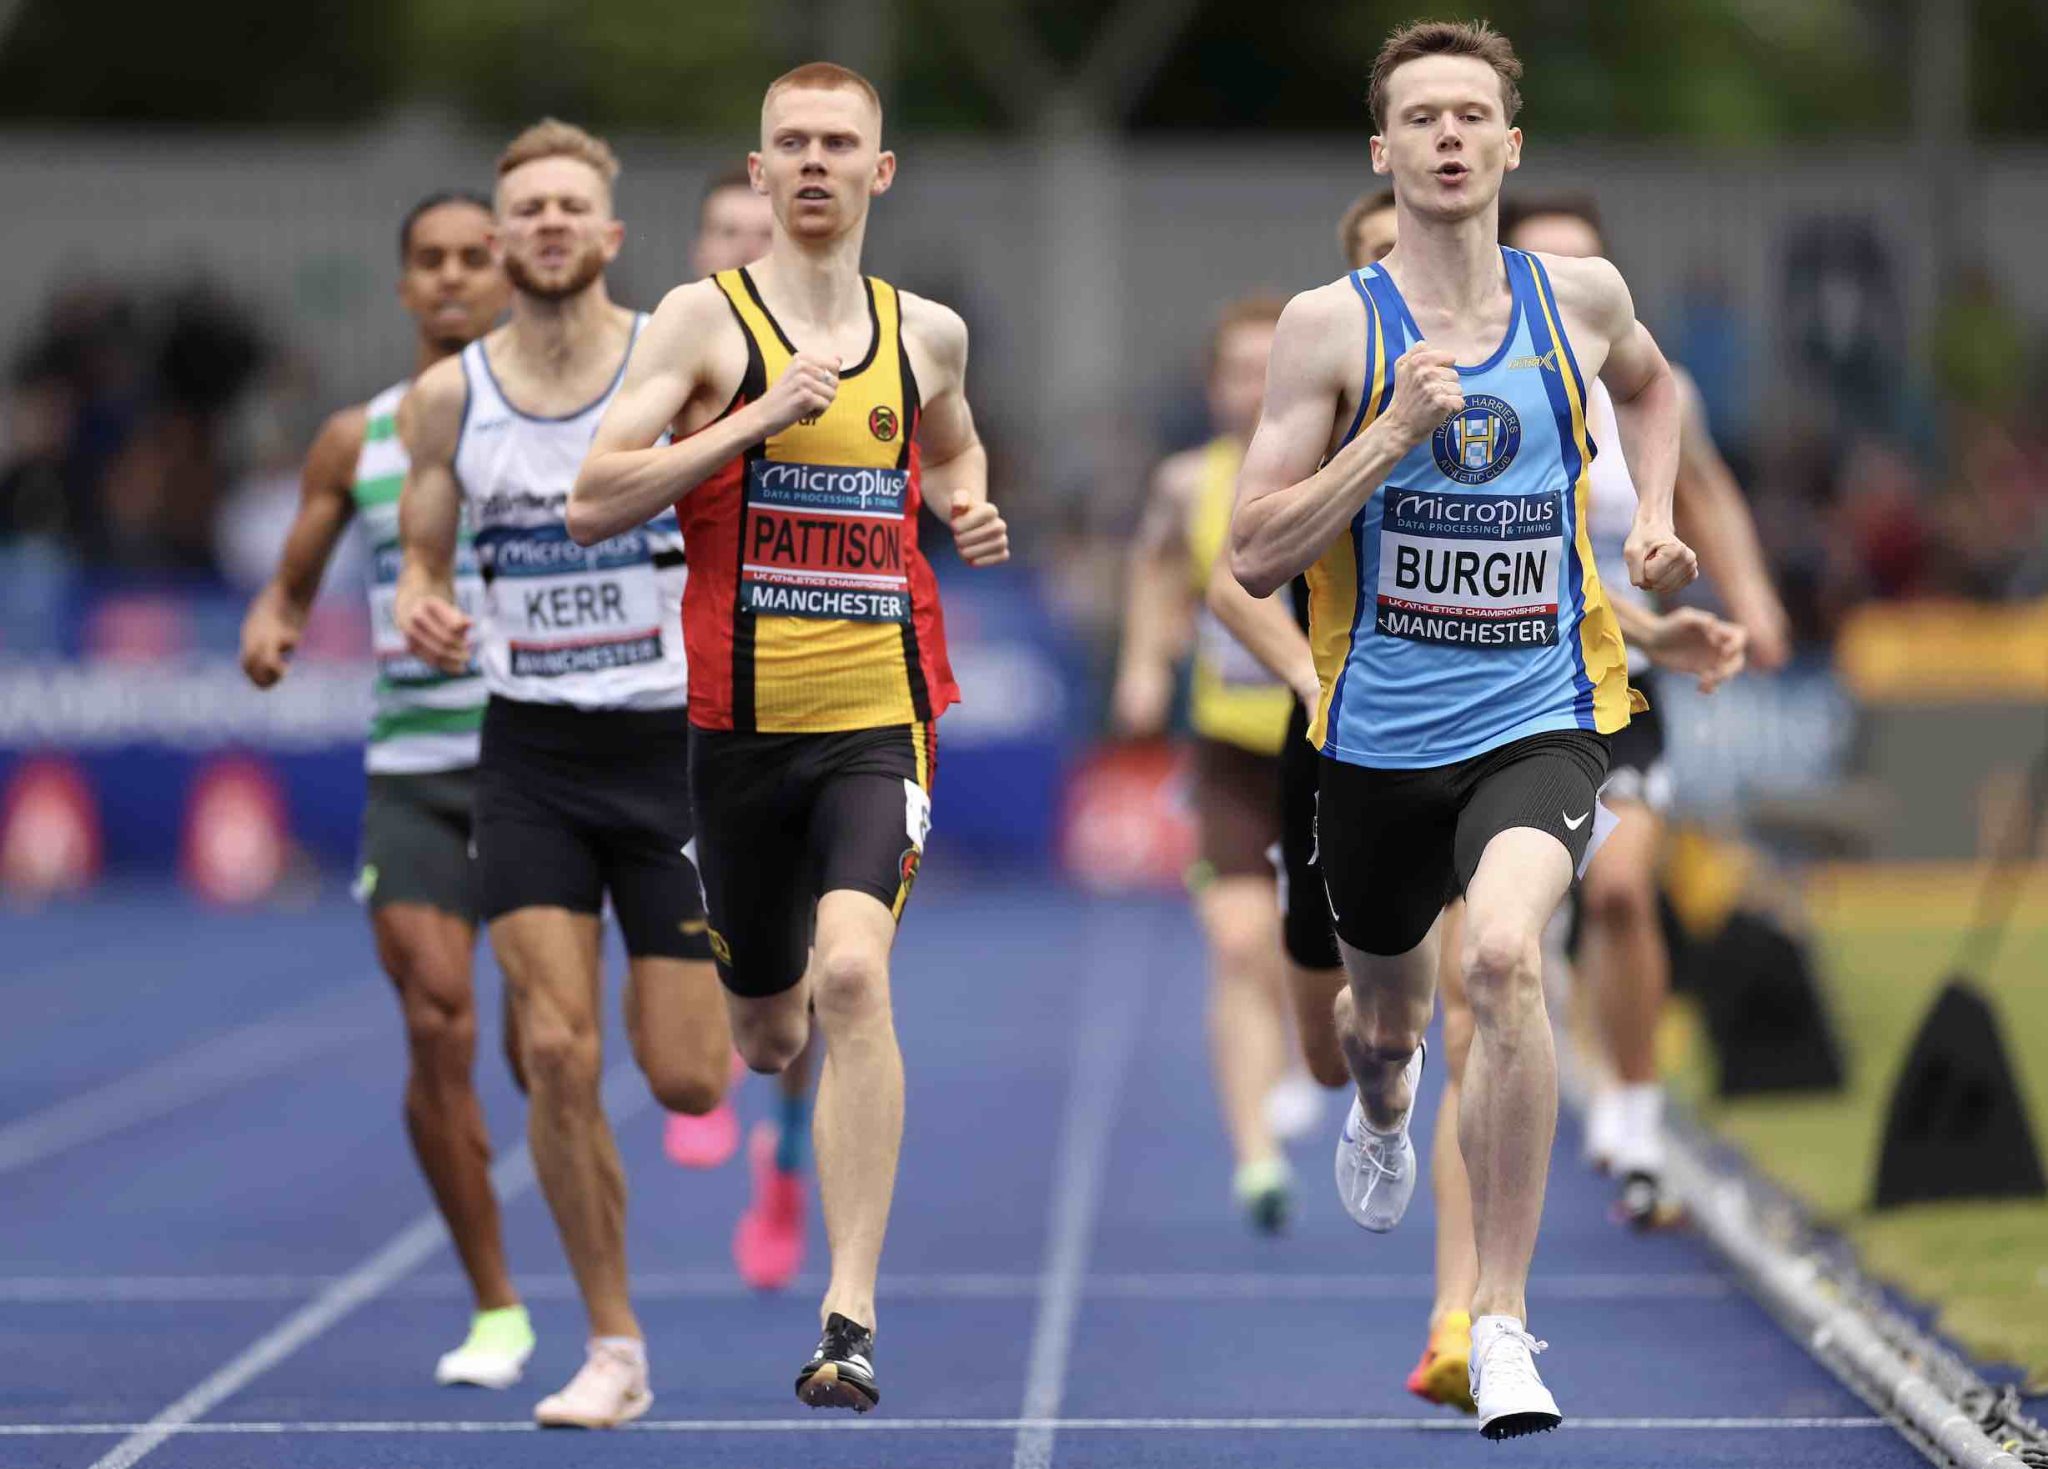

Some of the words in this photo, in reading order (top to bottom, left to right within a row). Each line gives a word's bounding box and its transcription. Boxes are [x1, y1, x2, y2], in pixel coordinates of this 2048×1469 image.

[1472, 397, 1518, 434] HARRIERS
[1440, 459, 1485, 483] ATHLETIC
[1486, 455, 1511, 478] CLUB
[763, 489, 790, 499] DATA
[794, 490, 860, 506] PROCESSING
[1397, 518, 1425, 530] DATA
[1429, 522, 1500, 534] PROCESSING
[1507, 525, 1514, 534] &
[1517, 522, 1551, 534] TIMING
[754, 516, 900, 569] PATTISON
[769, 573, 826, 586] ATHLETICS
[1395, 544, 1548, 598] BURGIN
[524, 582, 626, 630] KERR
[752, 586, 903, 616] MANCHESTER
[1389, 598, 1402, 607] UK
[1403, 602, 1463, 615] ATHLETICS
[1465, 605, 1547, 617] CHAMPIONSHIPS
[1387, 612, 1547, 644] MANCHESTER
